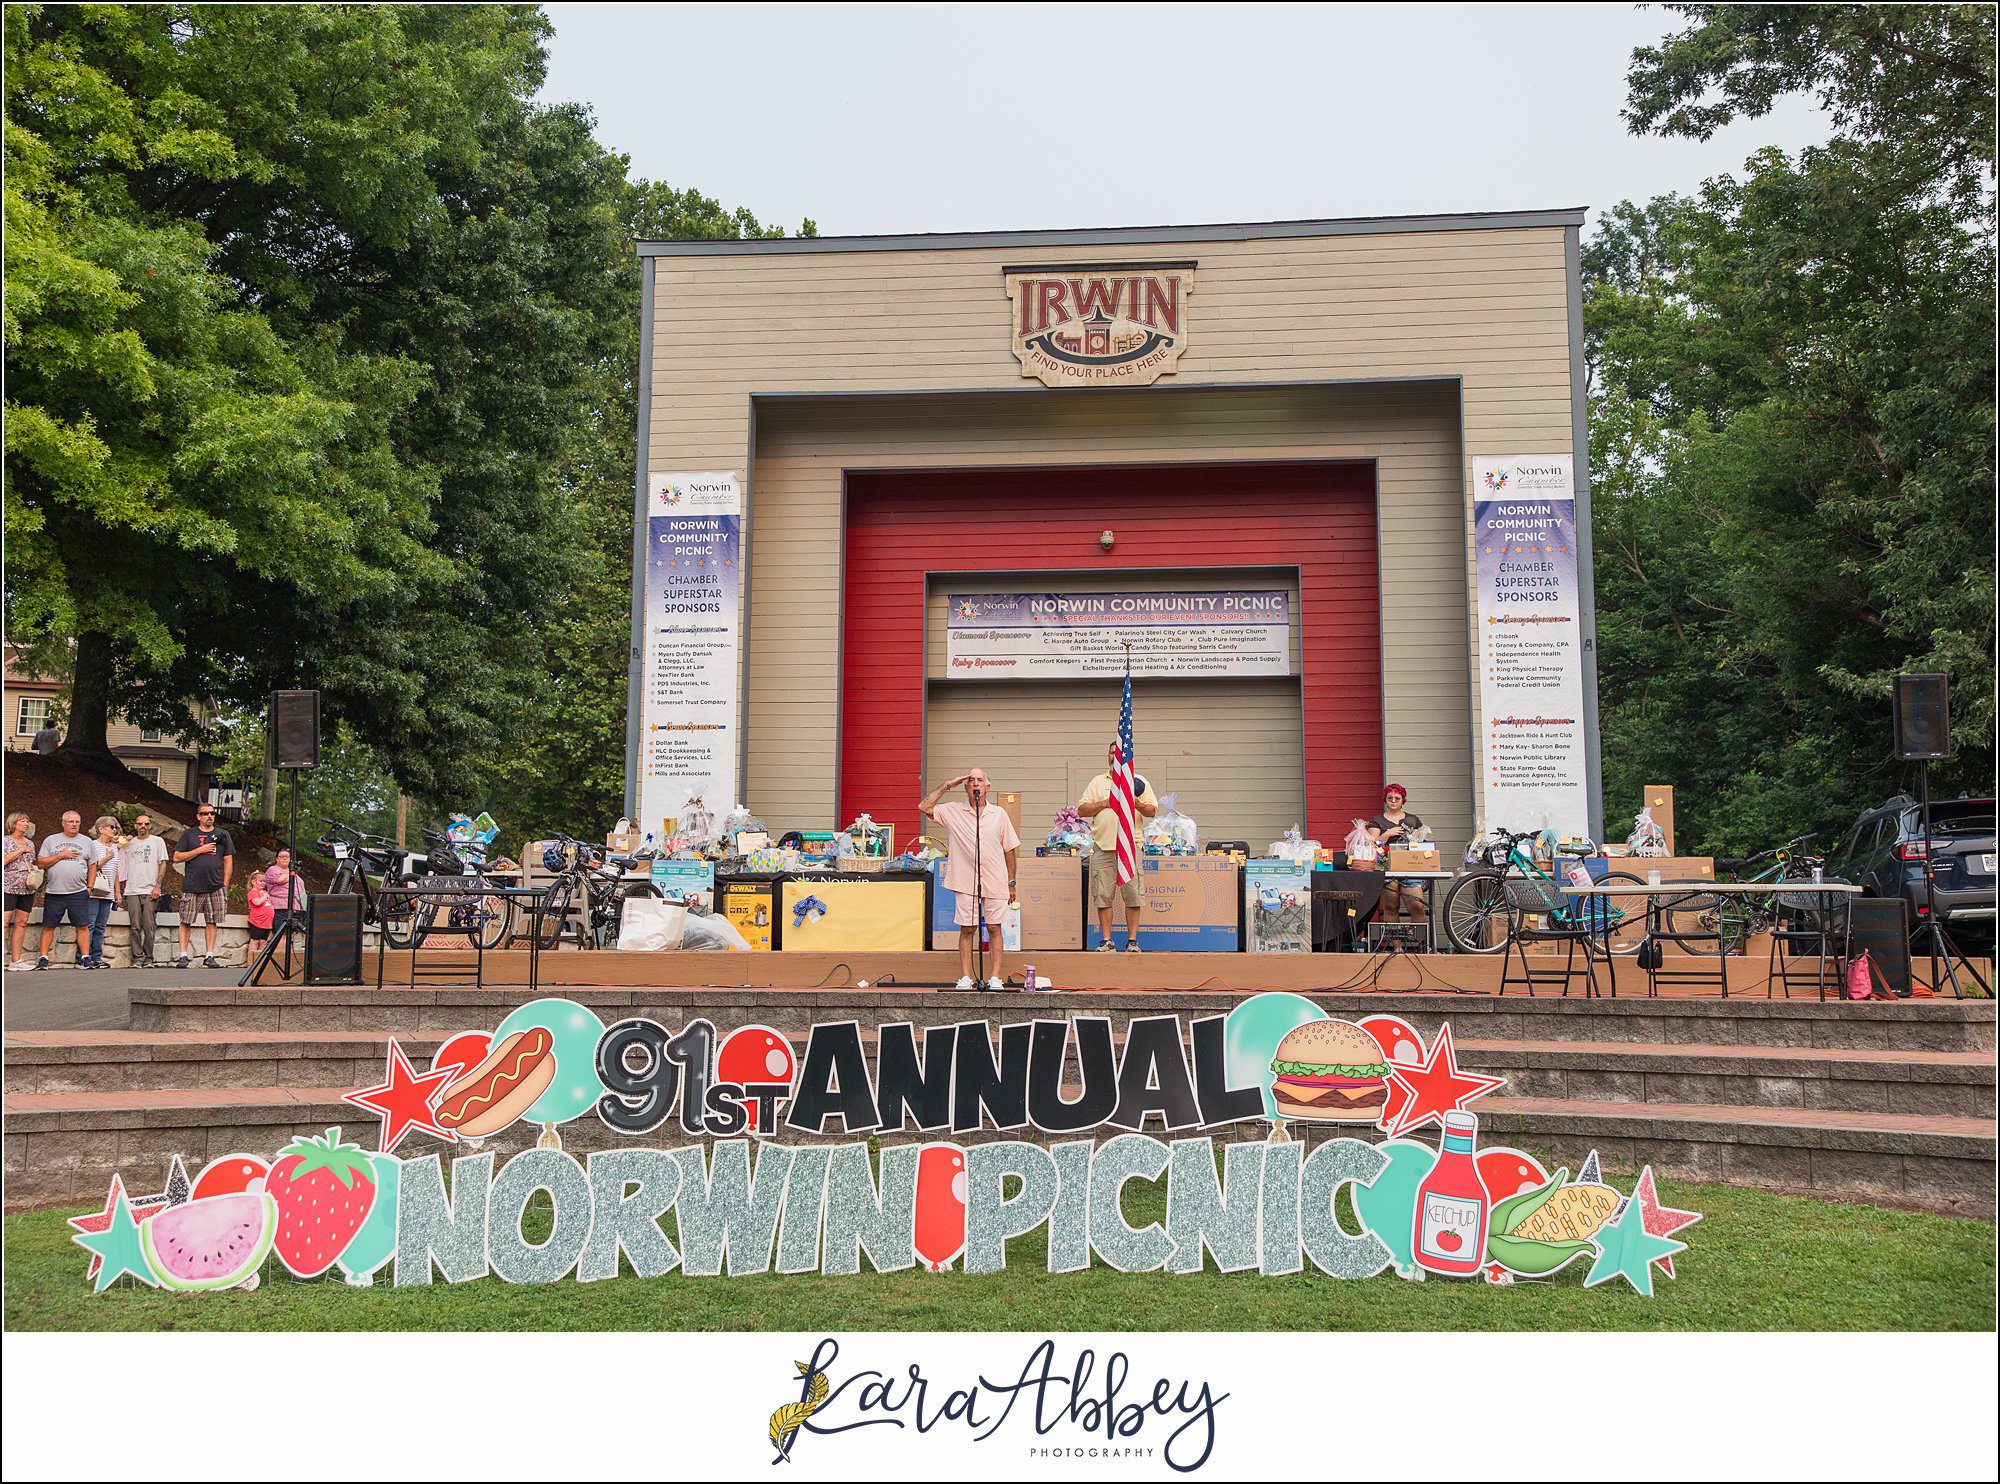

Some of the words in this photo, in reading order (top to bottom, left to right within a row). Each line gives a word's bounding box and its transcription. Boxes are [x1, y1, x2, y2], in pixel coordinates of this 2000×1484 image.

[1019, 276, 1180, 337] IRWIN
[1031, 351, 1058, 371] FIND
[1061, 365, 1092, 378] YOUR
[1096, 365, 1133, 378] PLACE
[1138, 349, 1168, 371] HERE
[1517, 465, 1562, 475] Norwin
[690, 482, 730, 492] Norwin
[1498, 506, 1550, 516] NORWIN
[670, 521, 719, 530] NORWIN
[1487, 519, 1562, 529] COMMUNITY
[660, 534, 728, 543] COMMUNITY
[1505, 532, 1546, 542] PICNIC
[675, 546, 713, 555] PICNIC
[1499, 562, 1554, 572] CHAMBER
[668, 575, 718, 584] CHAMBER
[1496, 577, 1559, 587] SUPERSTAR
[664, 589, 722, 598] SUPERSTAR
[1497, 592, 1558, 602] SPONSORS
[665, 603, 720, 613] SPONSORS
[1032, 599, 1104, 613] NORWIN
[1110, 597, 1216, 611] COMMUNITY
[1223, 596, 1282, 610] PICNIC
[952, 658, 973, 668] Ruby
[785, 1014, 1266, 1134] ANNUAL
[393, 1138, 917, 1288] NORWIN
[963, 1134, 1396, 1280] PICNIC
[1428, 1204, 1475, 1227] KETCHUP
